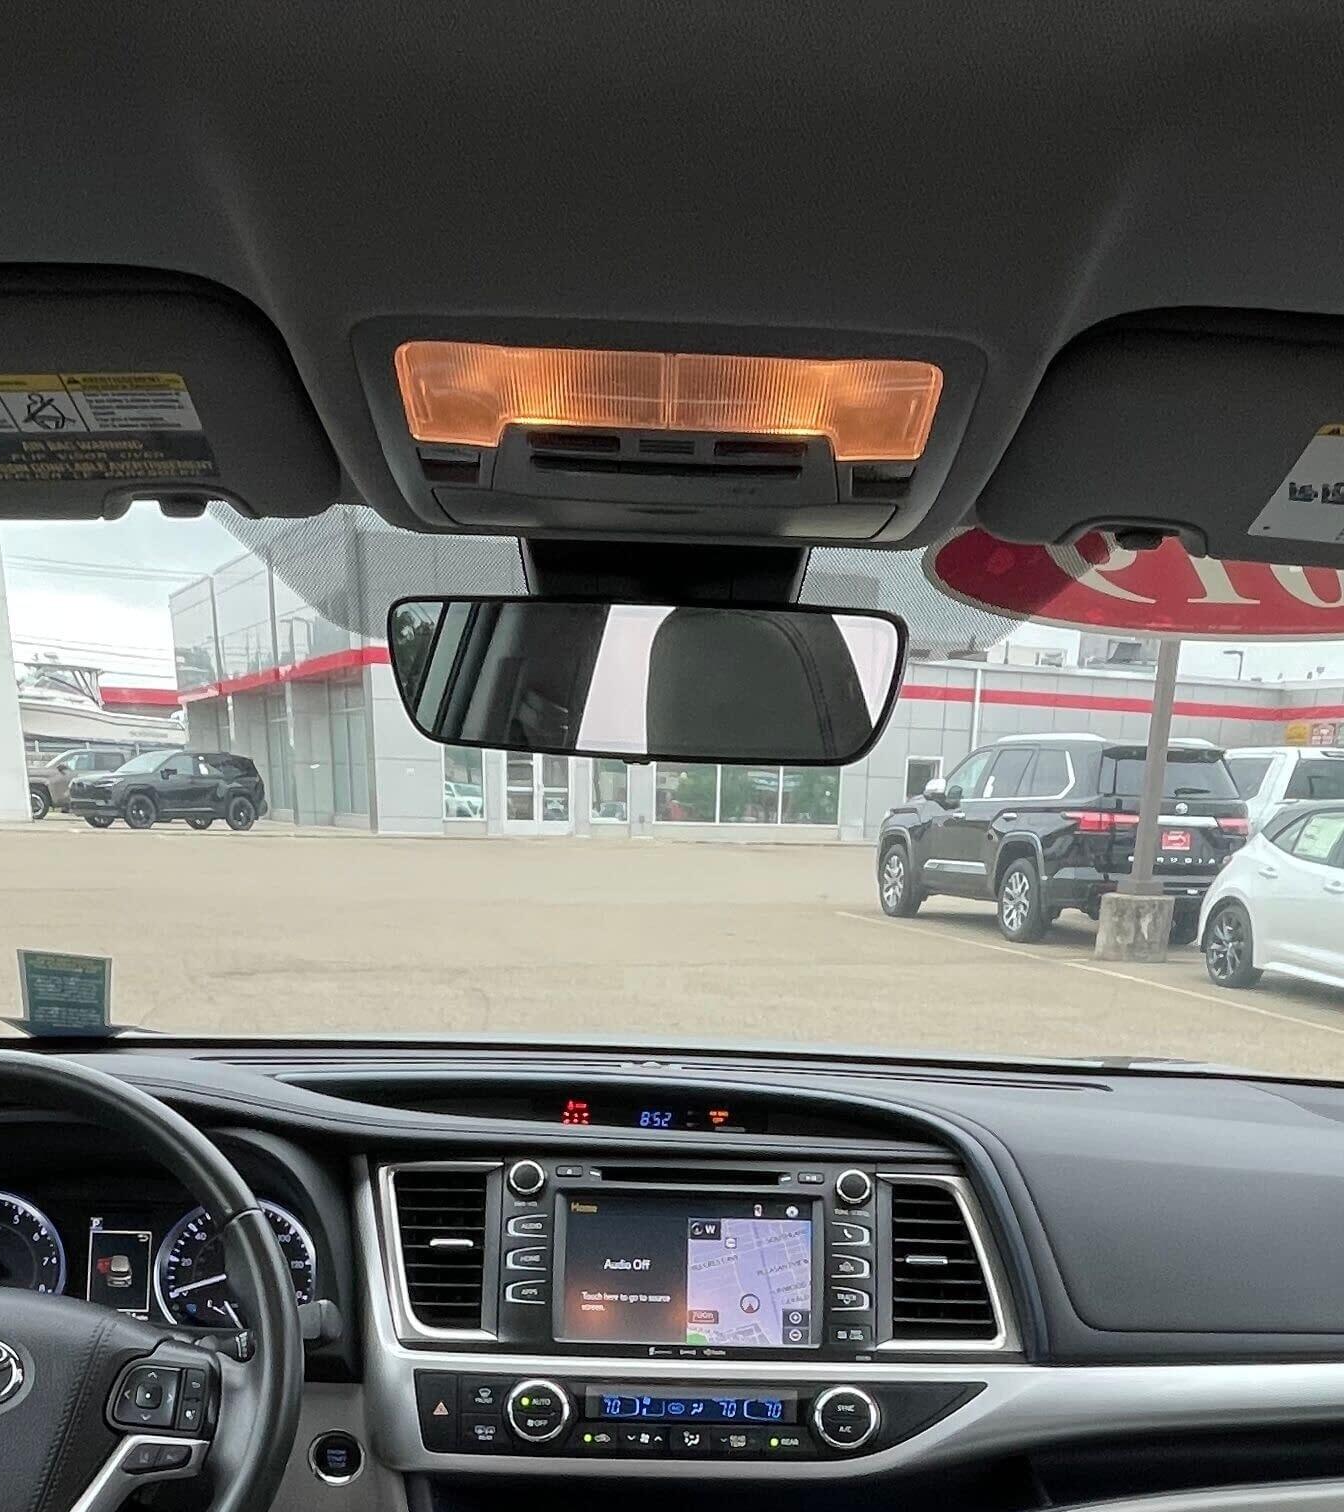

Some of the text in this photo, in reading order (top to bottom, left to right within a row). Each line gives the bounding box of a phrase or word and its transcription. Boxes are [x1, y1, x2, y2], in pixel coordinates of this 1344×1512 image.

[640, 1111, 672, 1127] 8:52
[706, 1225, 716, 1234] W
[604, 1258, 652, 1270] Audio Off
[581, 1291, 603, 1301] Touch
[532, 1398, 552, 1406] AUTO
[719, 1402, 737, 1418] 70
[765, 1402, 783, 1418] 70
